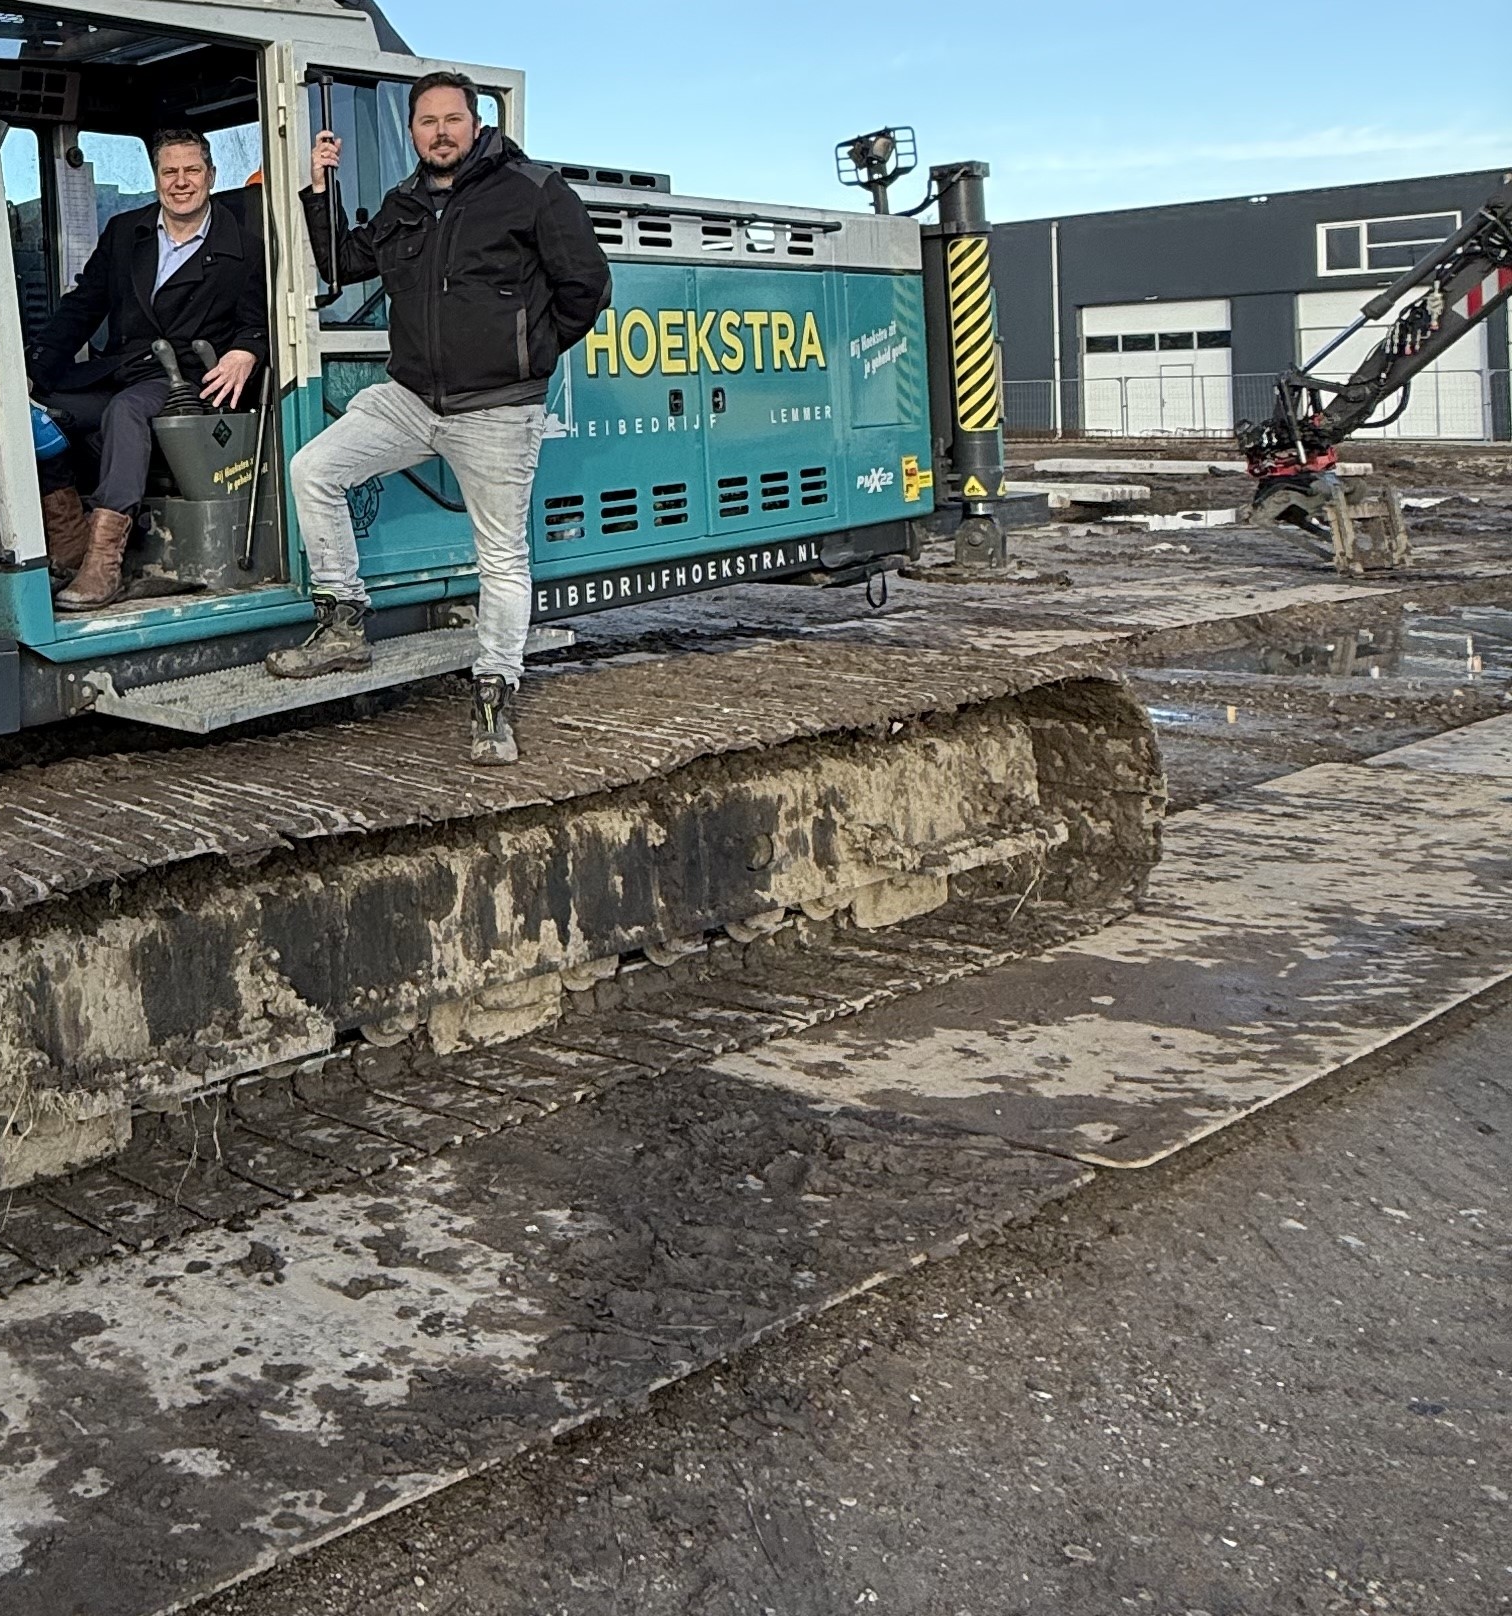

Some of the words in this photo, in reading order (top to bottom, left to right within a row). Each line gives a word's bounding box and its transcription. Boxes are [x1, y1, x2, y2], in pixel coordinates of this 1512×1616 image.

[585, 308, 827, 377] HOEKSTRA
[569, 413, 718, 438] HEIBEDRIJF
[769, 404, 833, 425] LEMMER
[537, 541, 820, 612] EIBEDRIJFHOEKSTRA.NL
